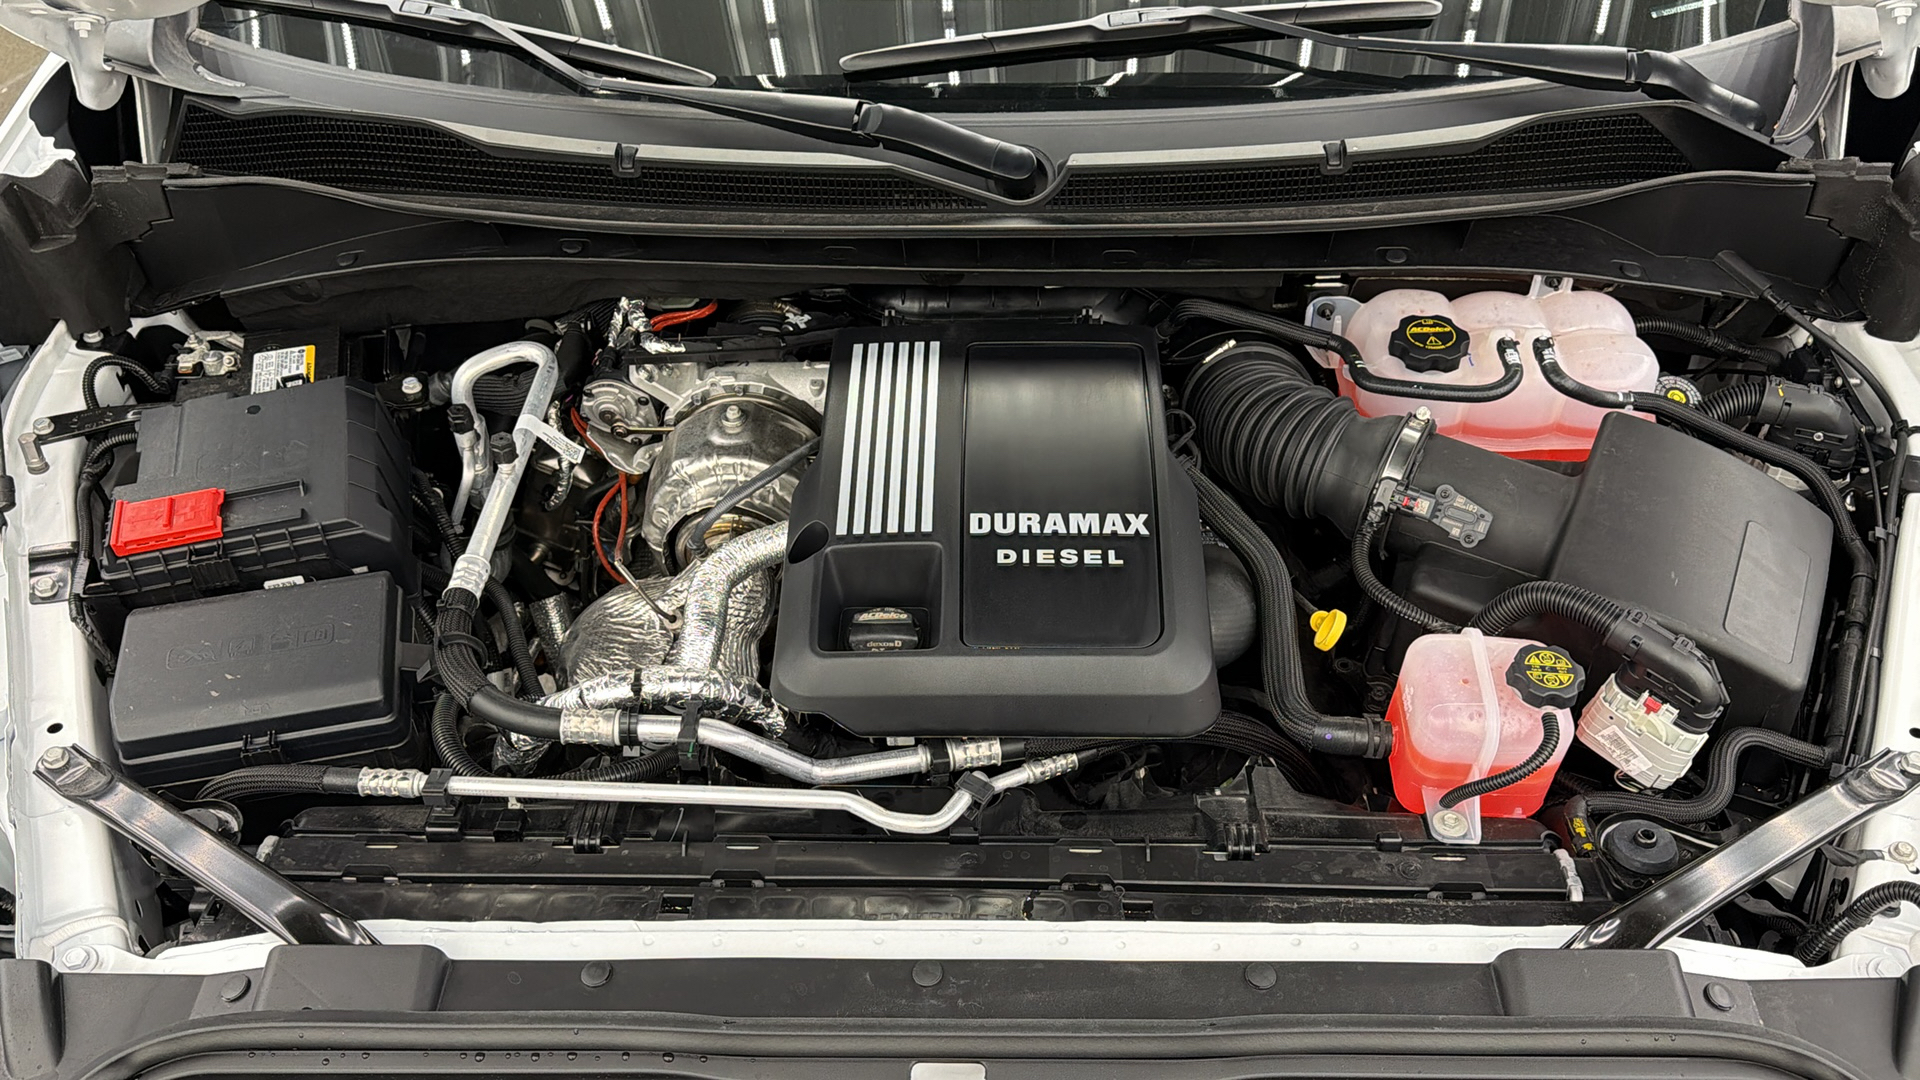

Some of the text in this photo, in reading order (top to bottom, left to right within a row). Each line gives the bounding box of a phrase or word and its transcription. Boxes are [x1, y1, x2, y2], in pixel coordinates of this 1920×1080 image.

[969, 512, 1150, 537] DURAMAX
[996, 548, 1125, 567] DIESEL
[858, 611, 908, 621] ACDelco
